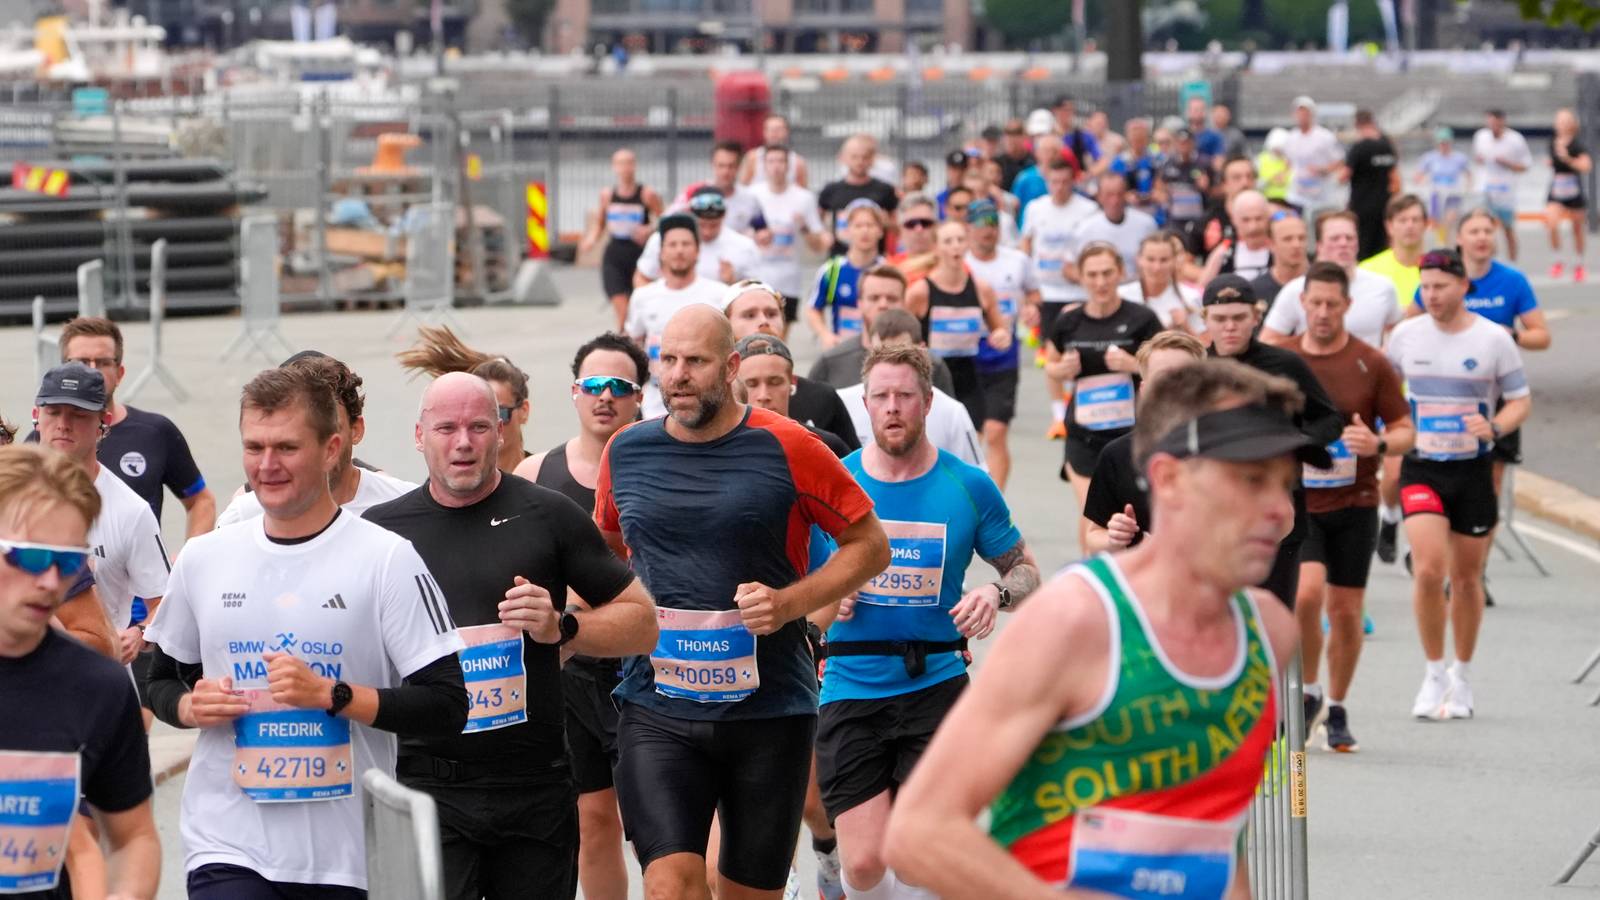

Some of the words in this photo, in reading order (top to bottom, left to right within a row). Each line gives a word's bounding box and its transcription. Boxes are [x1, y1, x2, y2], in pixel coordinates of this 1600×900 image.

[221, 592, 247, 600] REMA
[223, 600, 242, 608] 1000
[228, 640, 265, 654] BMW
[301, 641, 343, 656] OSLO
[676, 639, 730, 653] THOMAS
[233, 660, 342, 681] MAON
[460, 655, 511, 673] OHNNY
[674, 666, 737, 685] 40059
[258, 722, 324, 737] FREDRIK
[256, 756, 326, 779] 42719
[1034, 741, 1199, 824] SOUTH
[0, 794, 41, 816] RTE
[0, 837, 38, 863] 44
